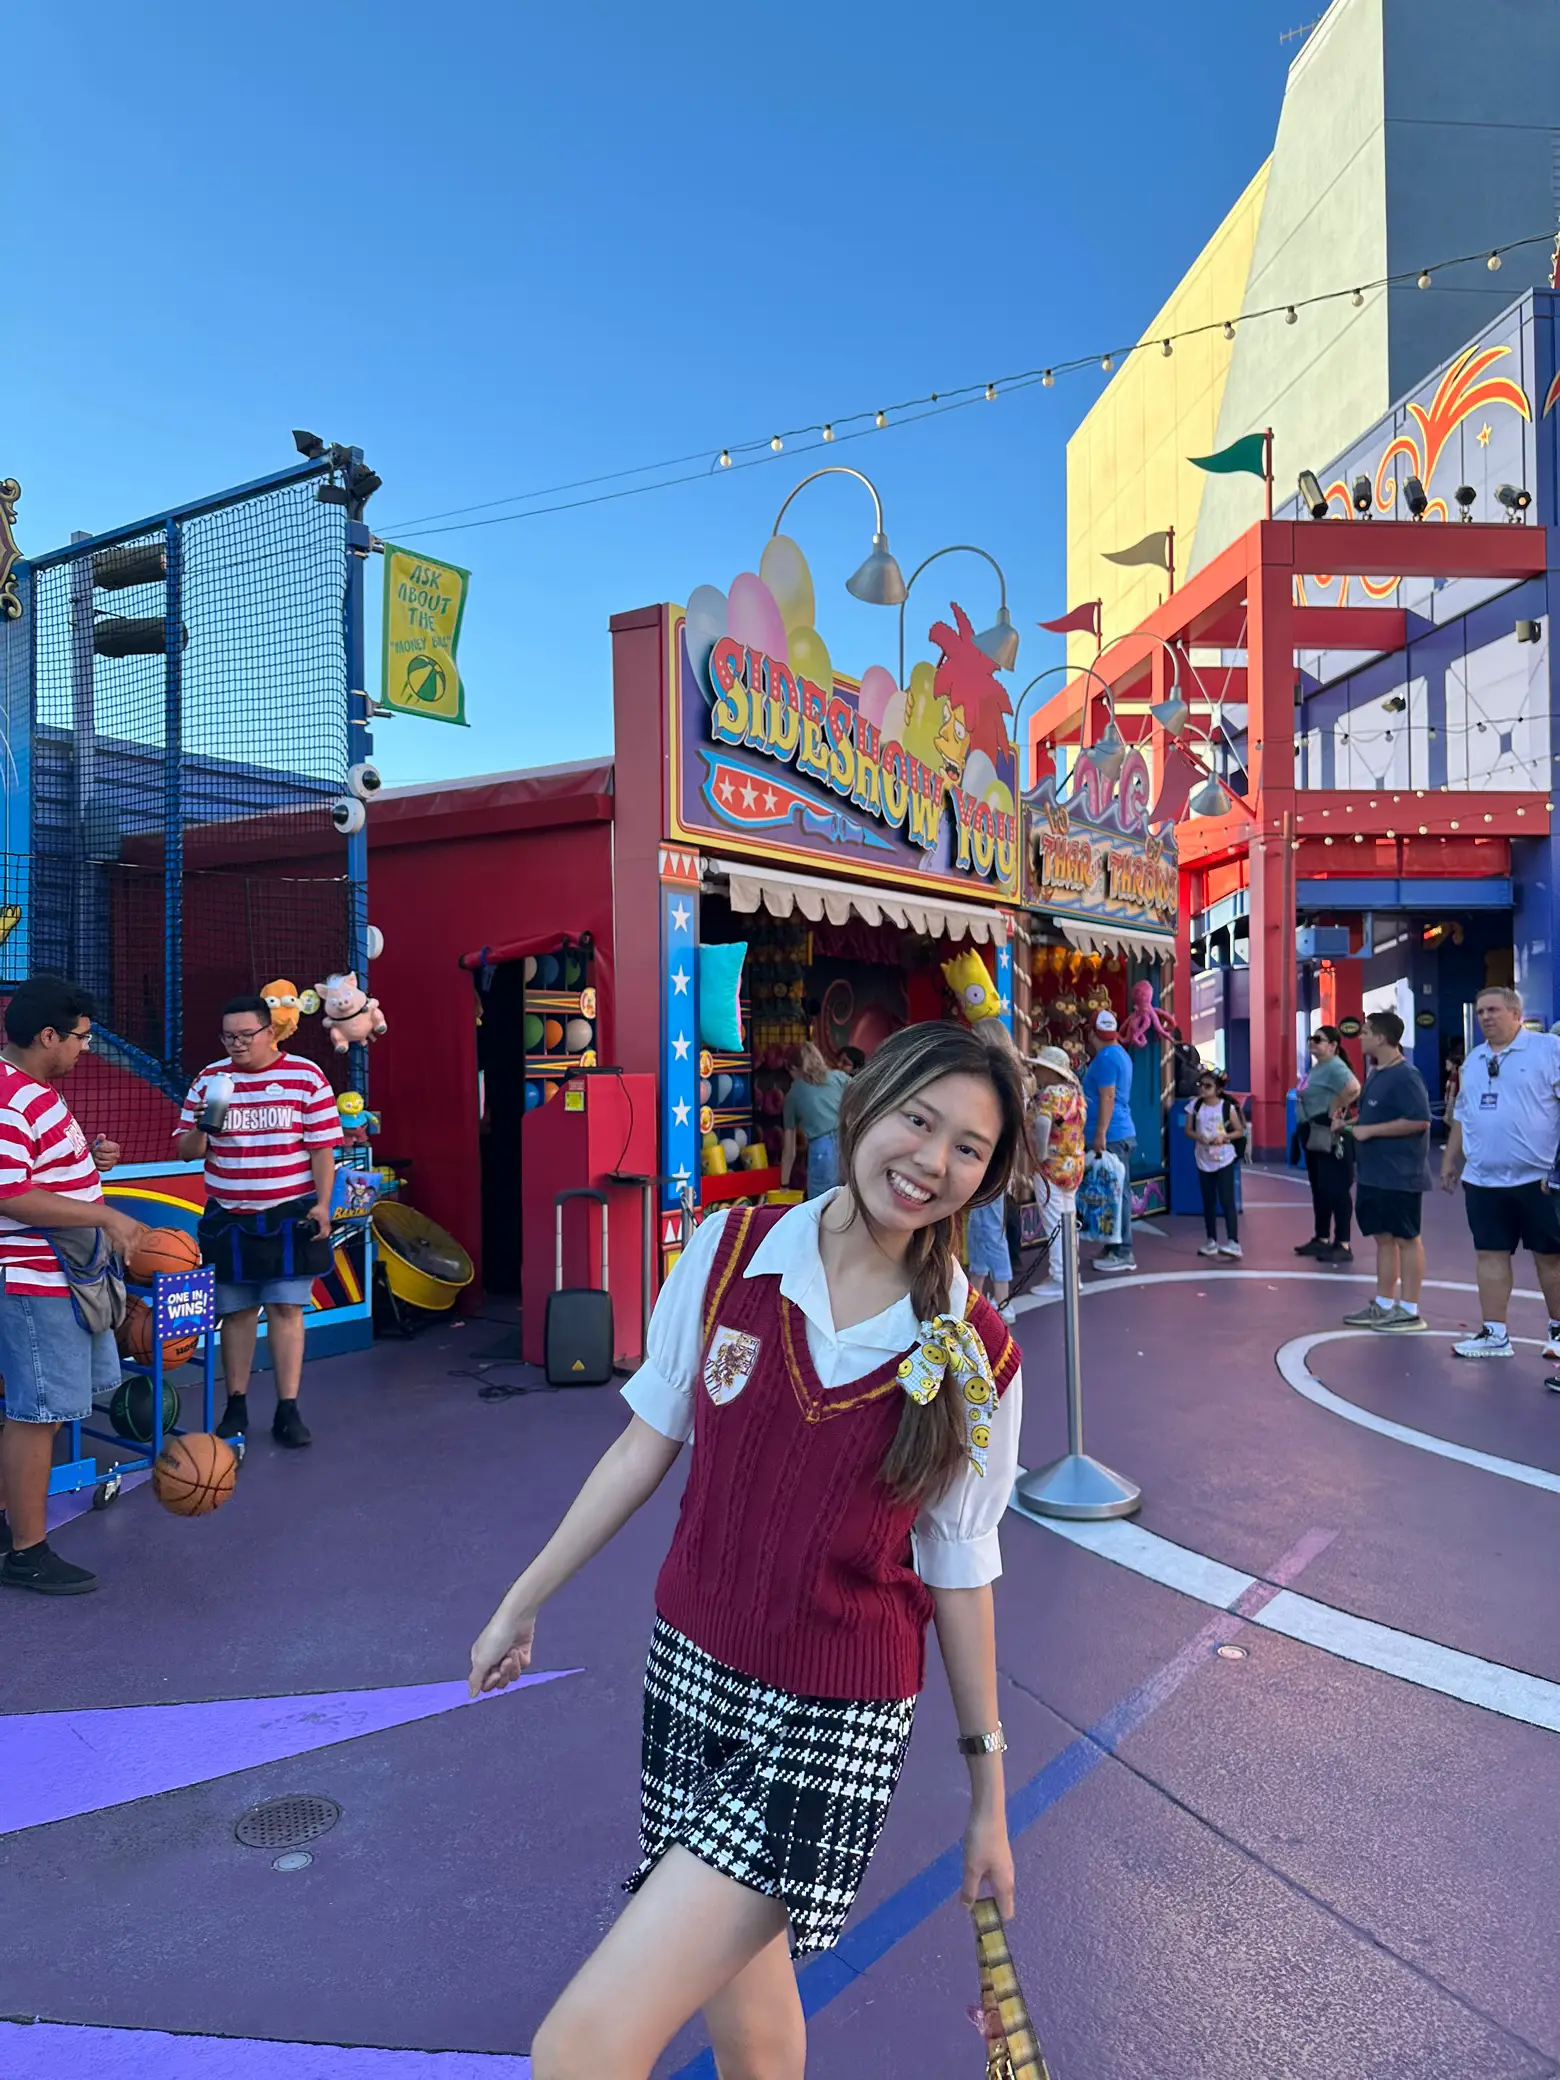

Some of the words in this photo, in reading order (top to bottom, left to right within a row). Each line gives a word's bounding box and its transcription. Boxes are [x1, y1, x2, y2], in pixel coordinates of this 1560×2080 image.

[409, 565, 443, 590] ASK
[398, 582, 453, 615] ABOUT
[408, 607, 436, 632] THE
[709, 637, 945, 852] SIDESHOW
[950, 784, 1015, 883] YOU
[1039, 833, 1094, 890] THAR
[168, 1291, 190, 1304] ONE
[191, 1289, 203, 1300] IN
[168, 1292, 208, 1319] WINS!
